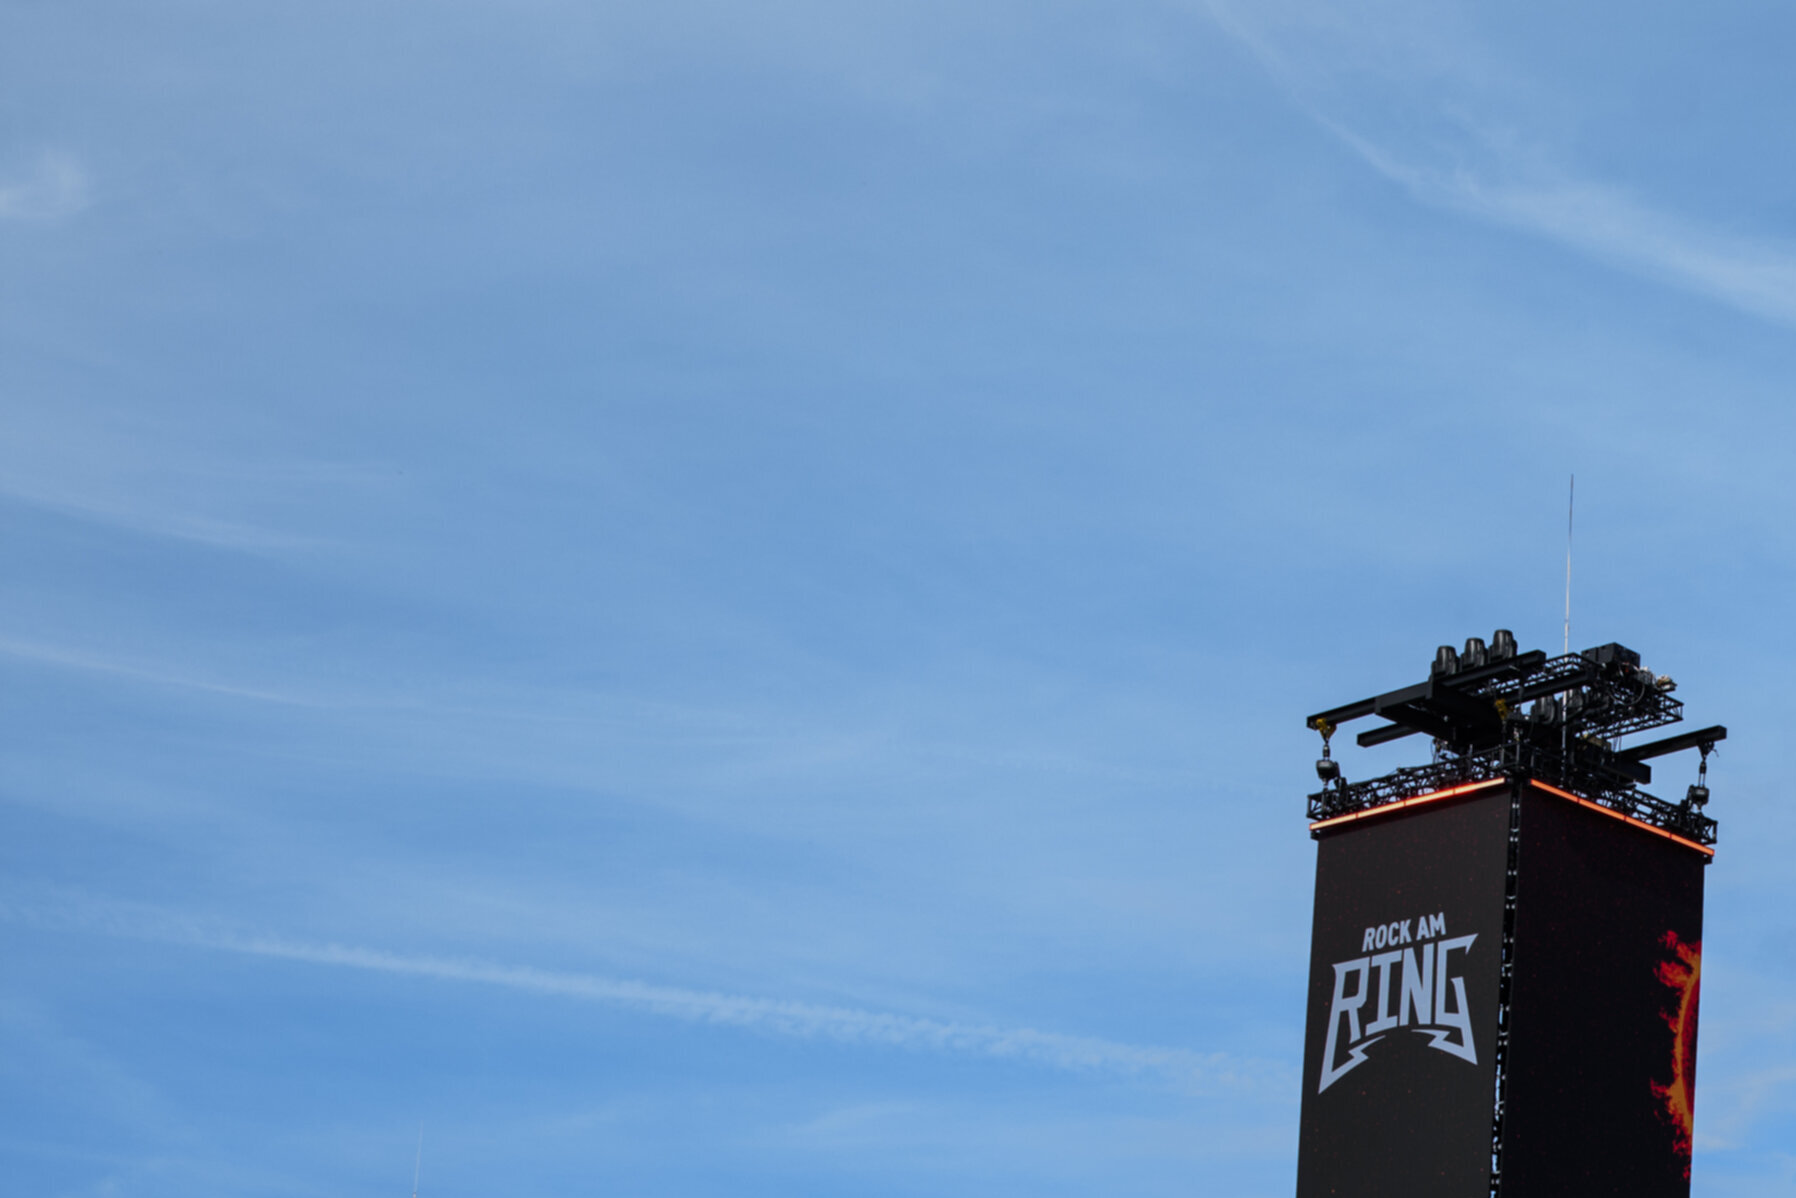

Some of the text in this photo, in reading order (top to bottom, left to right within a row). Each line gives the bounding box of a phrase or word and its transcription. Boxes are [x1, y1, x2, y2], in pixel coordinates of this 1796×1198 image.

[1362, 912, 1446, 951] ROCK AM
[1317, 933, 1479, 1096] RING
